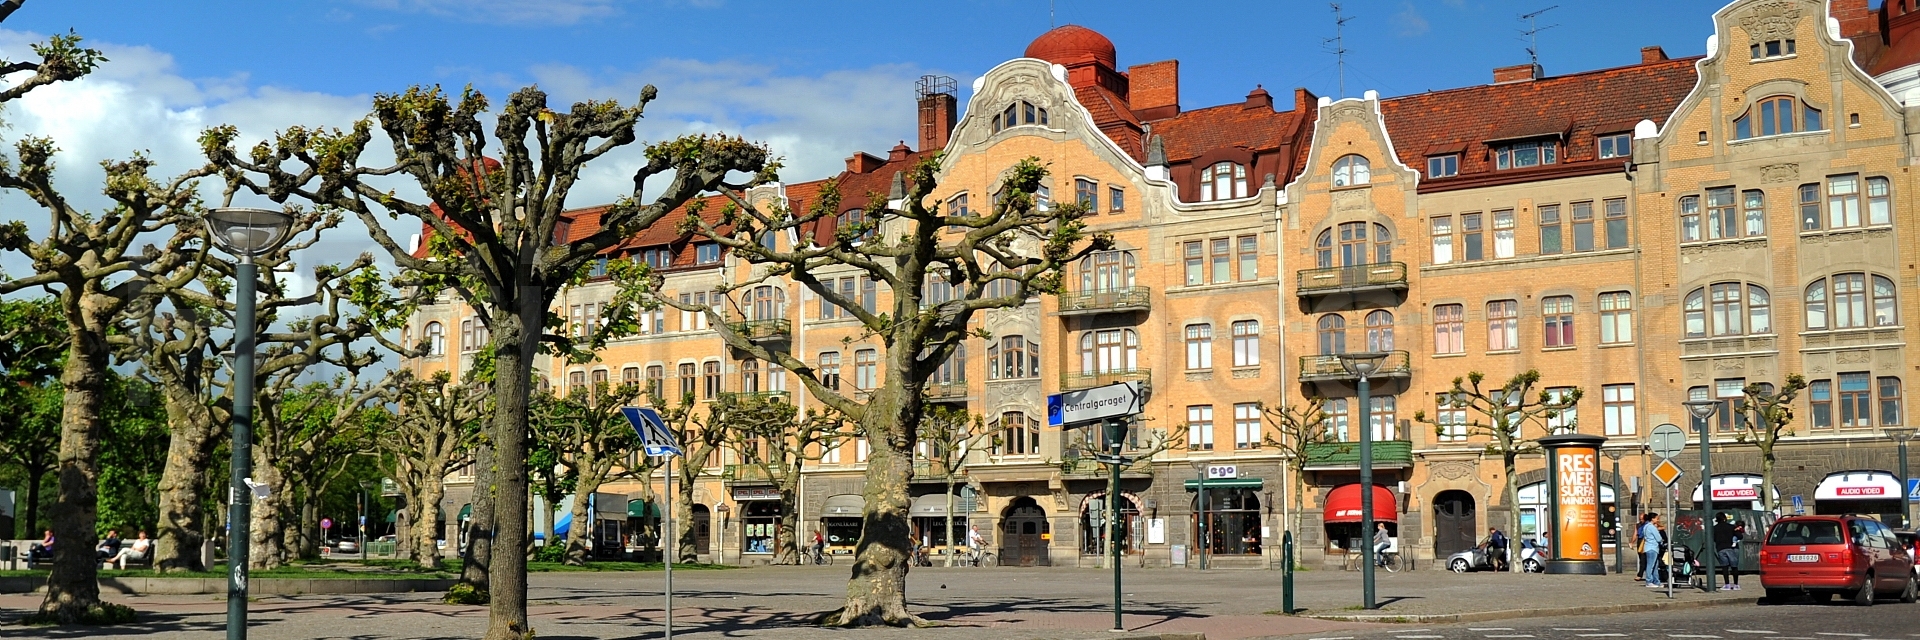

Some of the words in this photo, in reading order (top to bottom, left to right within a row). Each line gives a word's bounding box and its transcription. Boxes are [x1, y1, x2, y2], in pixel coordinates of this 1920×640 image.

[1065, 394, 1126, 413] Centralgaraget
[1559, 454, 1594, 472] RES
[1210, 466, 1234, 477] ego
[1561, 472, 1595, 486] MER
[1560, 486, 1595, 497] SURFA
[1561, 496, 1595, 505] MINDRE
